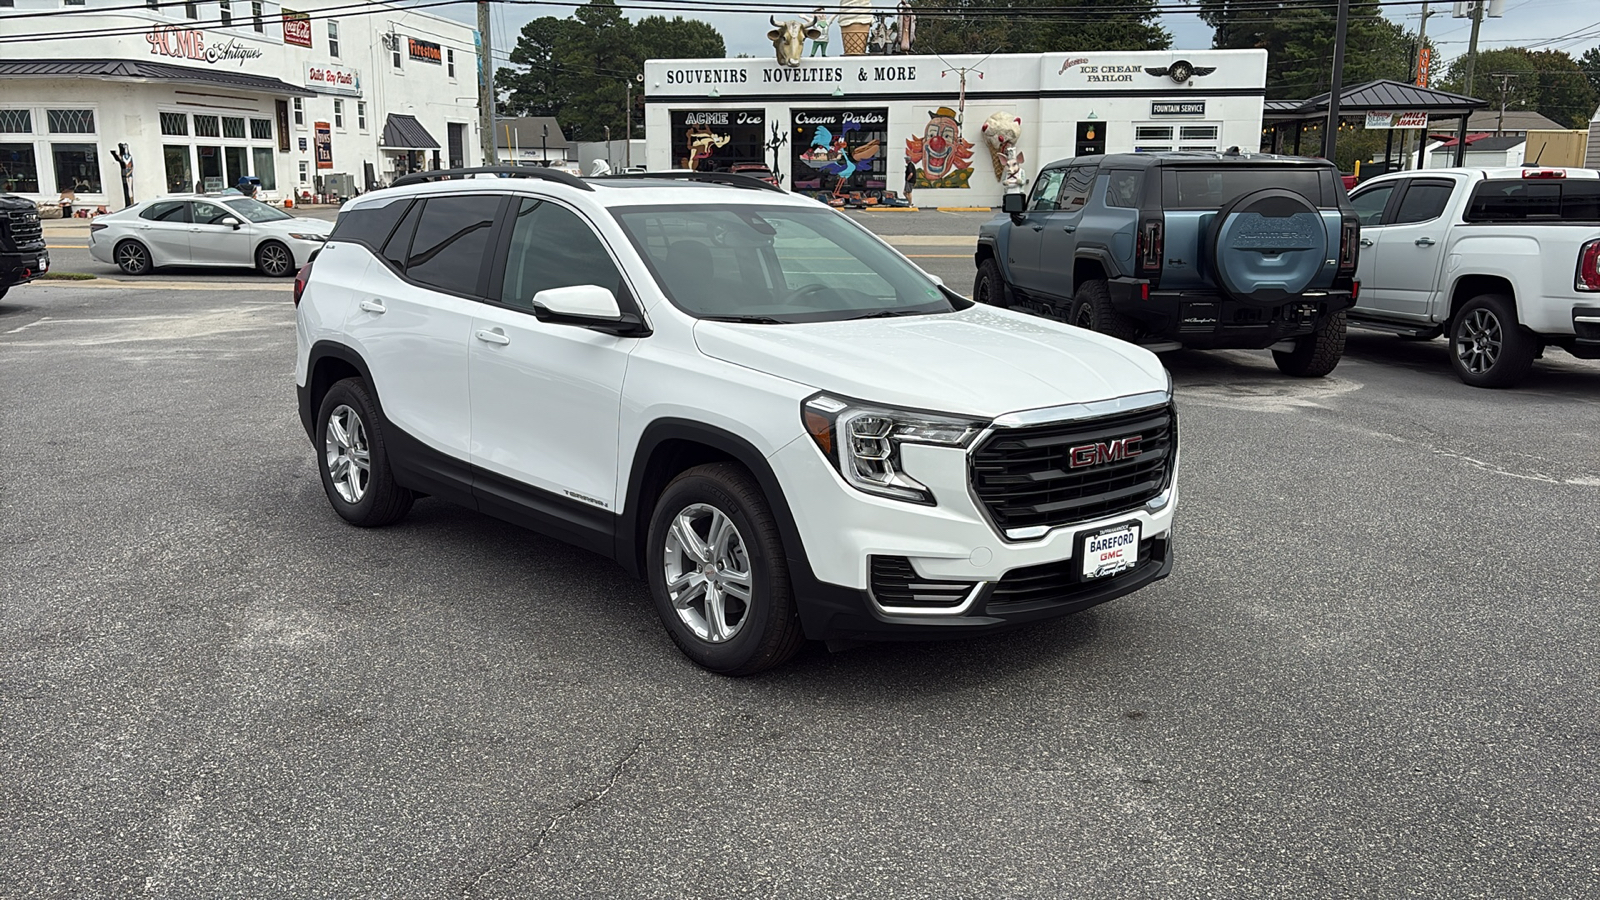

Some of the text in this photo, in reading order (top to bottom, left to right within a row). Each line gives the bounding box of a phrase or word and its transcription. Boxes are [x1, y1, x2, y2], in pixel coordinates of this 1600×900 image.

[146, 23, 206, 61] ACME
[217, 37, 262, 67] Antiques
[409, 38, 441, 60] Firestone
[666, 66, 916, 84] SOUVENIRS NOVELTIES & MORE
[1100, 65, 1142, 73] CREAM
[326, 70, 336, 86] Boy
[336, 71, 353, 85] Paints
[1153, 104, 1203, 113] FOUNTAIN SERVICE
[685, 112, 763, 125] ACME Ice
[795, 112, 885, 124] Cream Parlor
[1402, 111, 1427, 119] MILK
[1396, 119, 1426, 127] SHAKES
[320, 148, 331, 160] TEA
[1070, 435, 1142, 468] GMC
[1090, 532, 1134, 553] BAREFORD
[1100, 549, 1123, 561] GMC
